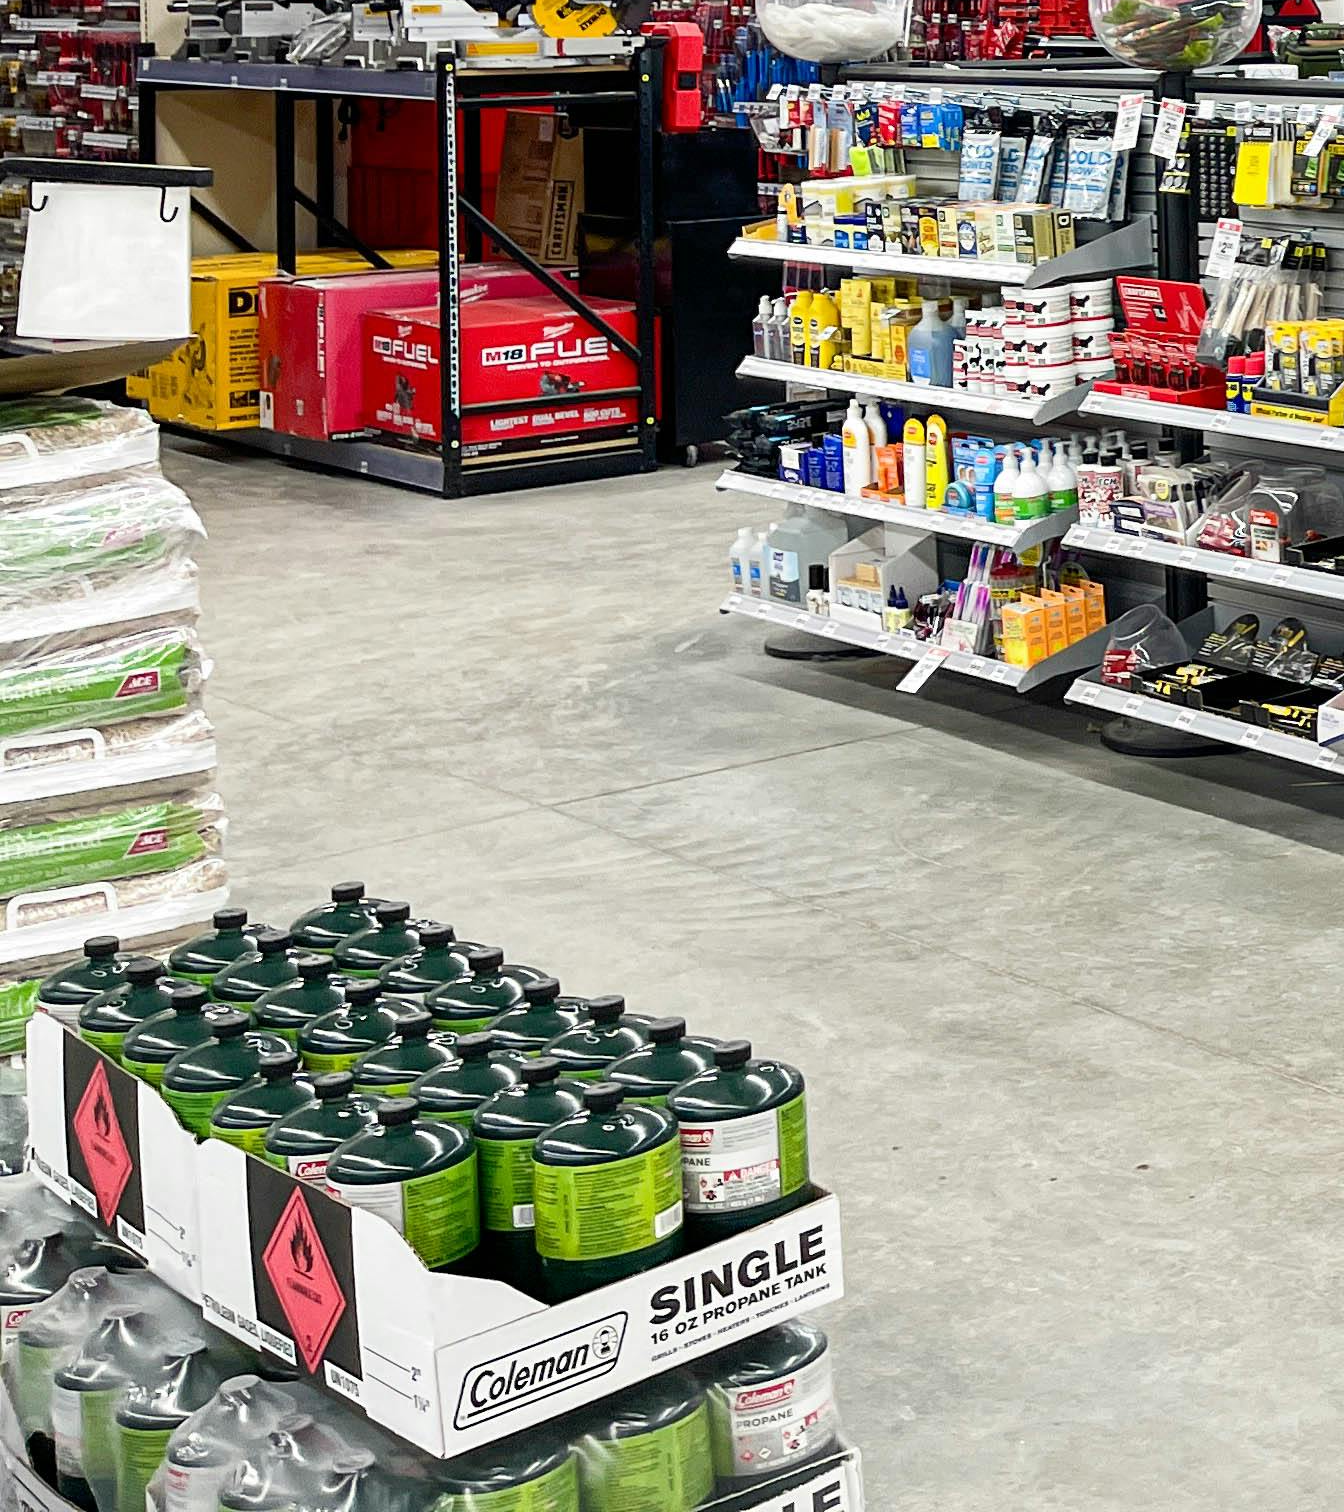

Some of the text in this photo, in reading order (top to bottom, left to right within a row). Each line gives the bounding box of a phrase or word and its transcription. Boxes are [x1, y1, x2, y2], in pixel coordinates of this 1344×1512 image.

[1068, 150, 1113, 166] COLD
[551, 185, 569, 257] CRAFTSMAN
[392, 343, 439, 365] FUEL
[485, 335, 623, 364] M18 FUE
[648, 1224, 826, 1326] SINGLE
[651, 1262, 827, 1345] 16 OZ PROPANE TANK
[469, 1344, 589, 1409] Coleman
[738, 1384, 785, 1407] Coleman
[735, 1408, 794, 1429] PROPANE
